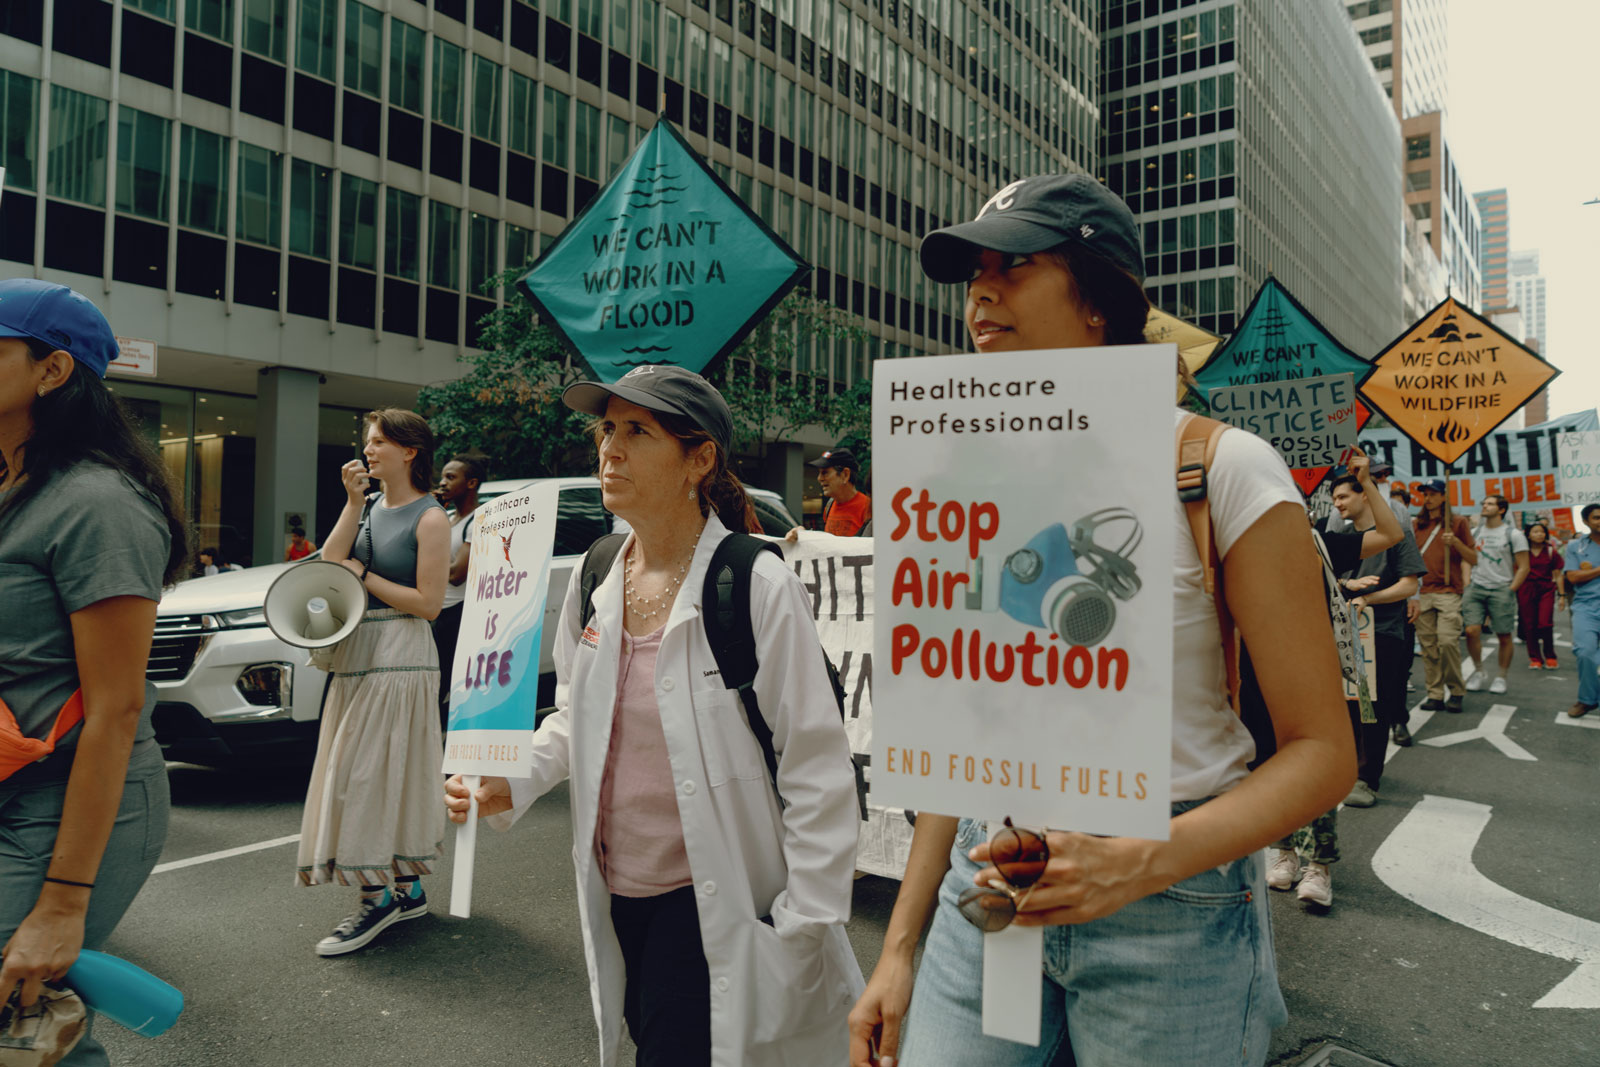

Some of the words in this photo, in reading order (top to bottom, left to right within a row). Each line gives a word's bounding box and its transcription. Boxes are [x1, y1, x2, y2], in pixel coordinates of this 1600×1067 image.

[593, 228, 629, 257] WE
[635, 220, 722, 252] CAN'T
[583, 263, 658, 295] WORK
[666, 260, 696, 286] IN
[705, 259, 727, 285] A
[599, 300, 695, 330] FLOOD
[1232, 349, 1261, 368] WE
[1264, 343, 1319, 363] CAN'T
[1400, 351, 1433, 368] WE
[1436, 347, 1500, 367] CAN'T
[890, 376, 1056, 402] Healthcare
[1394, 373, 1459, 390] WORK
[1465, 372, 1486, 389] IN
[1492, 370, 1508, 386] A
[1210, 380, 1347, 413] CLIMATE
[1400, 393, 1501, 412] WILDFIRE
[890, 408, 1090, 436] Professionals
[1327, 402, 1354, 425] NOW
[890, 486, 1000, 560] Stop
[476, 566, 528, 603] Water
[891, 556, 971, 611] Air
[484, 609, 499, 641] is
[465, 649, 515, 692] LIFE
[891, 623, 1130, 692] Pollution
[487, 743, 520, 762] FUELS
[887, 746, 931, 777] END
[948, 753, 1042, 790] FOSSIL
[1060, 765, 1148, 801] FUELS
